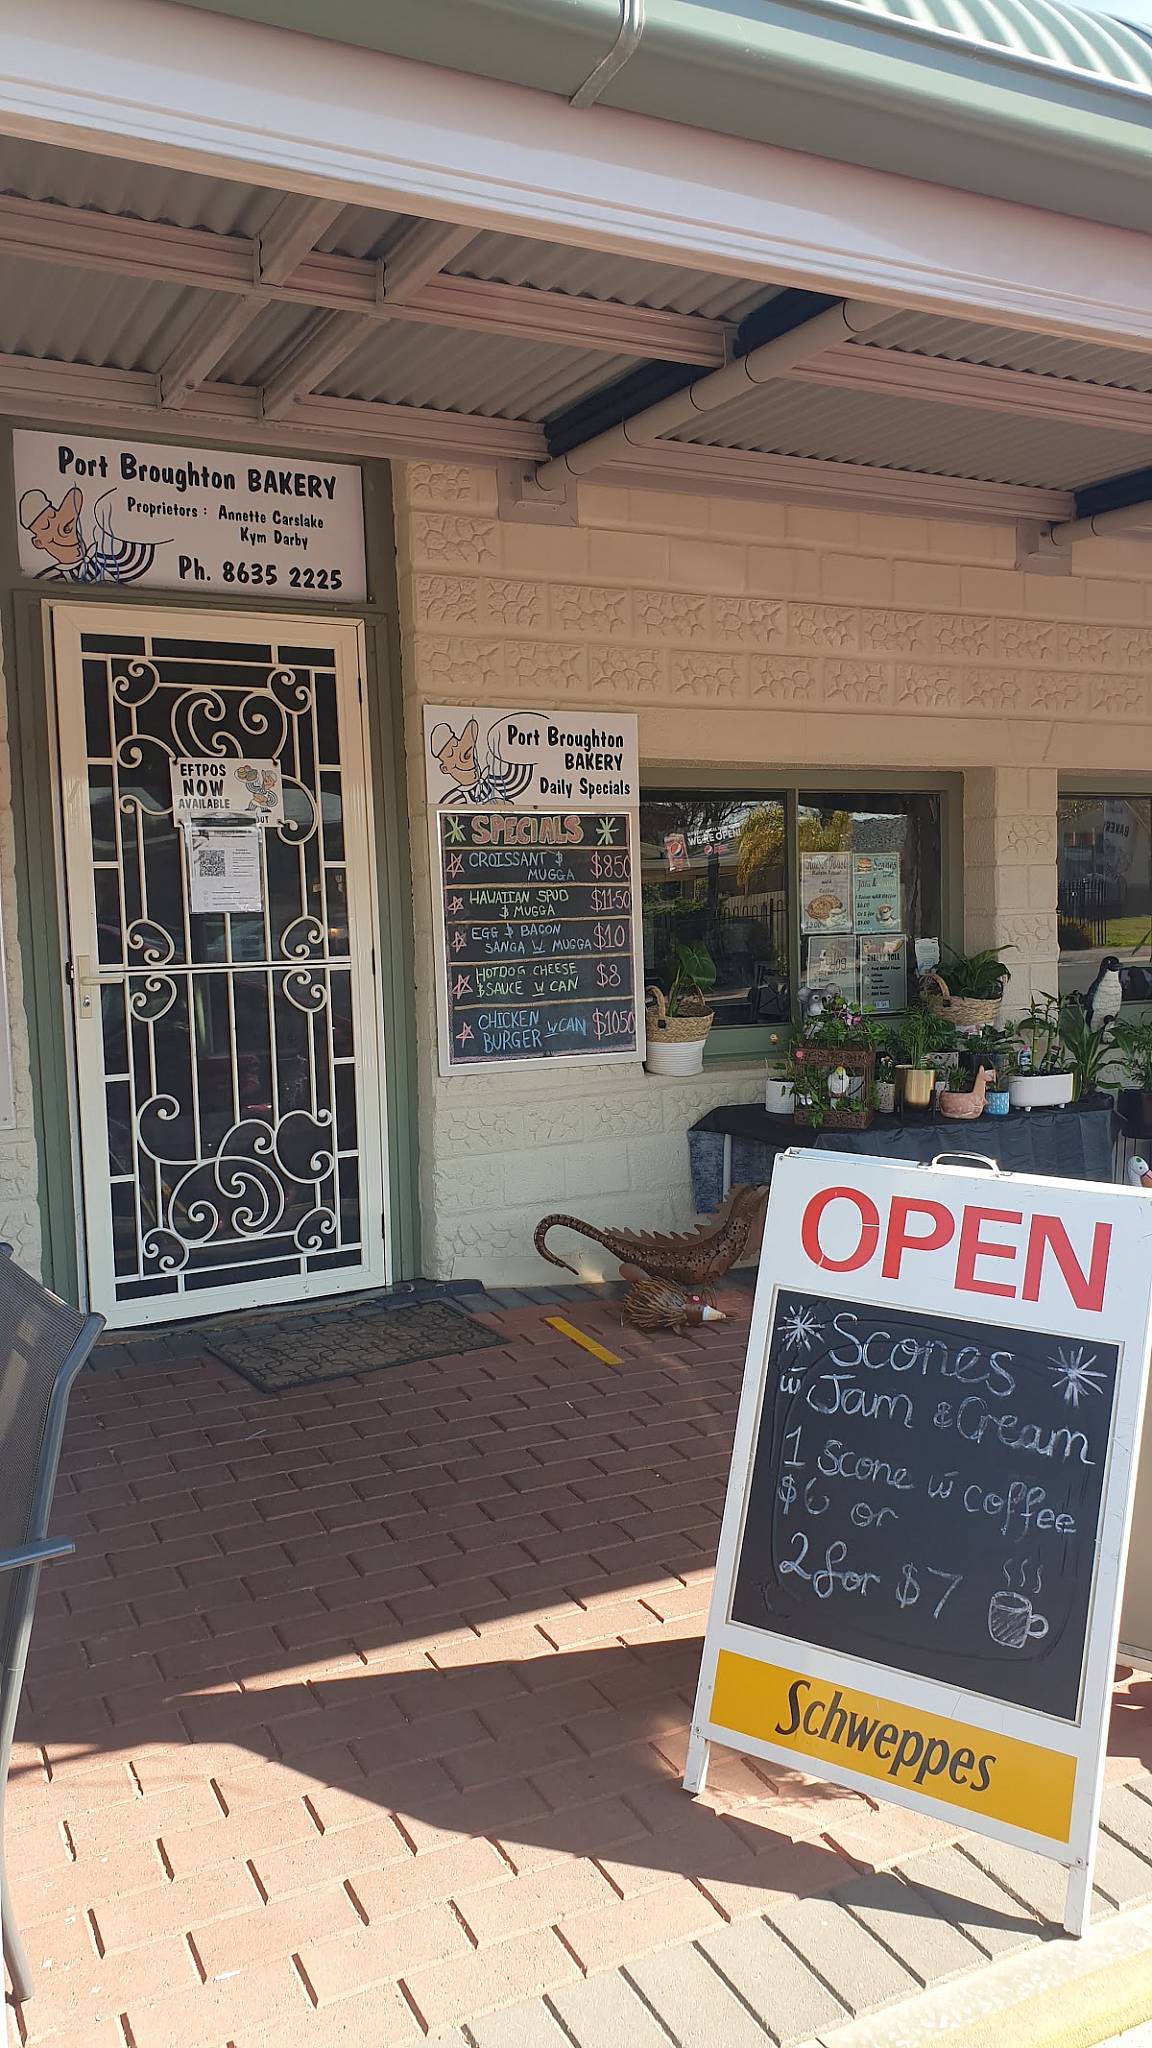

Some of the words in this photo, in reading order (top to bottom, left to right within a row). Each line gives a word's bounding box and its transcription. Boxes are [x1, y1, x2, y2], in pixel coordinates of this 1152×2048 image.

[58, 445, 108, 478] Port
[120, 452, 236, 492] Broughton
[248, 469, 337, 499] BAKERY
[127, 496, 198, 518] Proprietors
[219, 505, 266, 524] Annette
[272, 510, 324, 529] Carslake
[240, 526, 267, 548] Kym
[274, 530, 309, 550] Darby
[178, 555, 211, 581] Ph.
[222, 561, 278, 586] 8635
[289, 567, 343, 591] 2225
[507, 725, 540, 746] Port
[548, 726, 624, 752] Broughton
[180, 763, 226, 777] EFTPOS
[565, 753, 623, 771] BAKERY
[183, 779, 224, 797] NOW
[540, 777, 572, 799] Daily
[579, 778, 631, 799] Specials
[179, 798, 230, 809] AVAILABLE
[471, 815, 584, 845] SPECIALS
[469, 851, 547, 868] CROISSANT
[527, 868, 575, 881] MUGGA
[536, 889, 569, 903] SPUD
[513, 905, 556, 918] MUGGA
[471, 927, 498, 940] EGG
[520, 923, 561, 938] BACON
[593, 922, 626, 950] $10
[485, 941, 525, 955] SANGA
[552, 938, 592, 952] MUGGA
[475, 965, 526, 984] HOTDOG
[533, 962, 577, 977] CHEESE
[596, 962, 621, 988] $8
[549, 976, 579, 993] CAN
[478, 1010, 540, 1030] CHICKEN
[483, 1029, 543, 1054] BURGER
[800, 1186, 1114, 1313] OPEN
[828, 1312, 1016, 1397] Scones
[806, 1373, 913, 1429] Jam
[957, 1396, 1096, 1465] Cream
[784, 1425, 806, 1468] 1
[778, 1474, 830, 1515] $6
[851, 1502, 900, 1527] or
[779, 1532, 812, 1580] 2
[896, 1562, 963, 1619] $7
[774, 1679, 998, 1793] Schweppes
